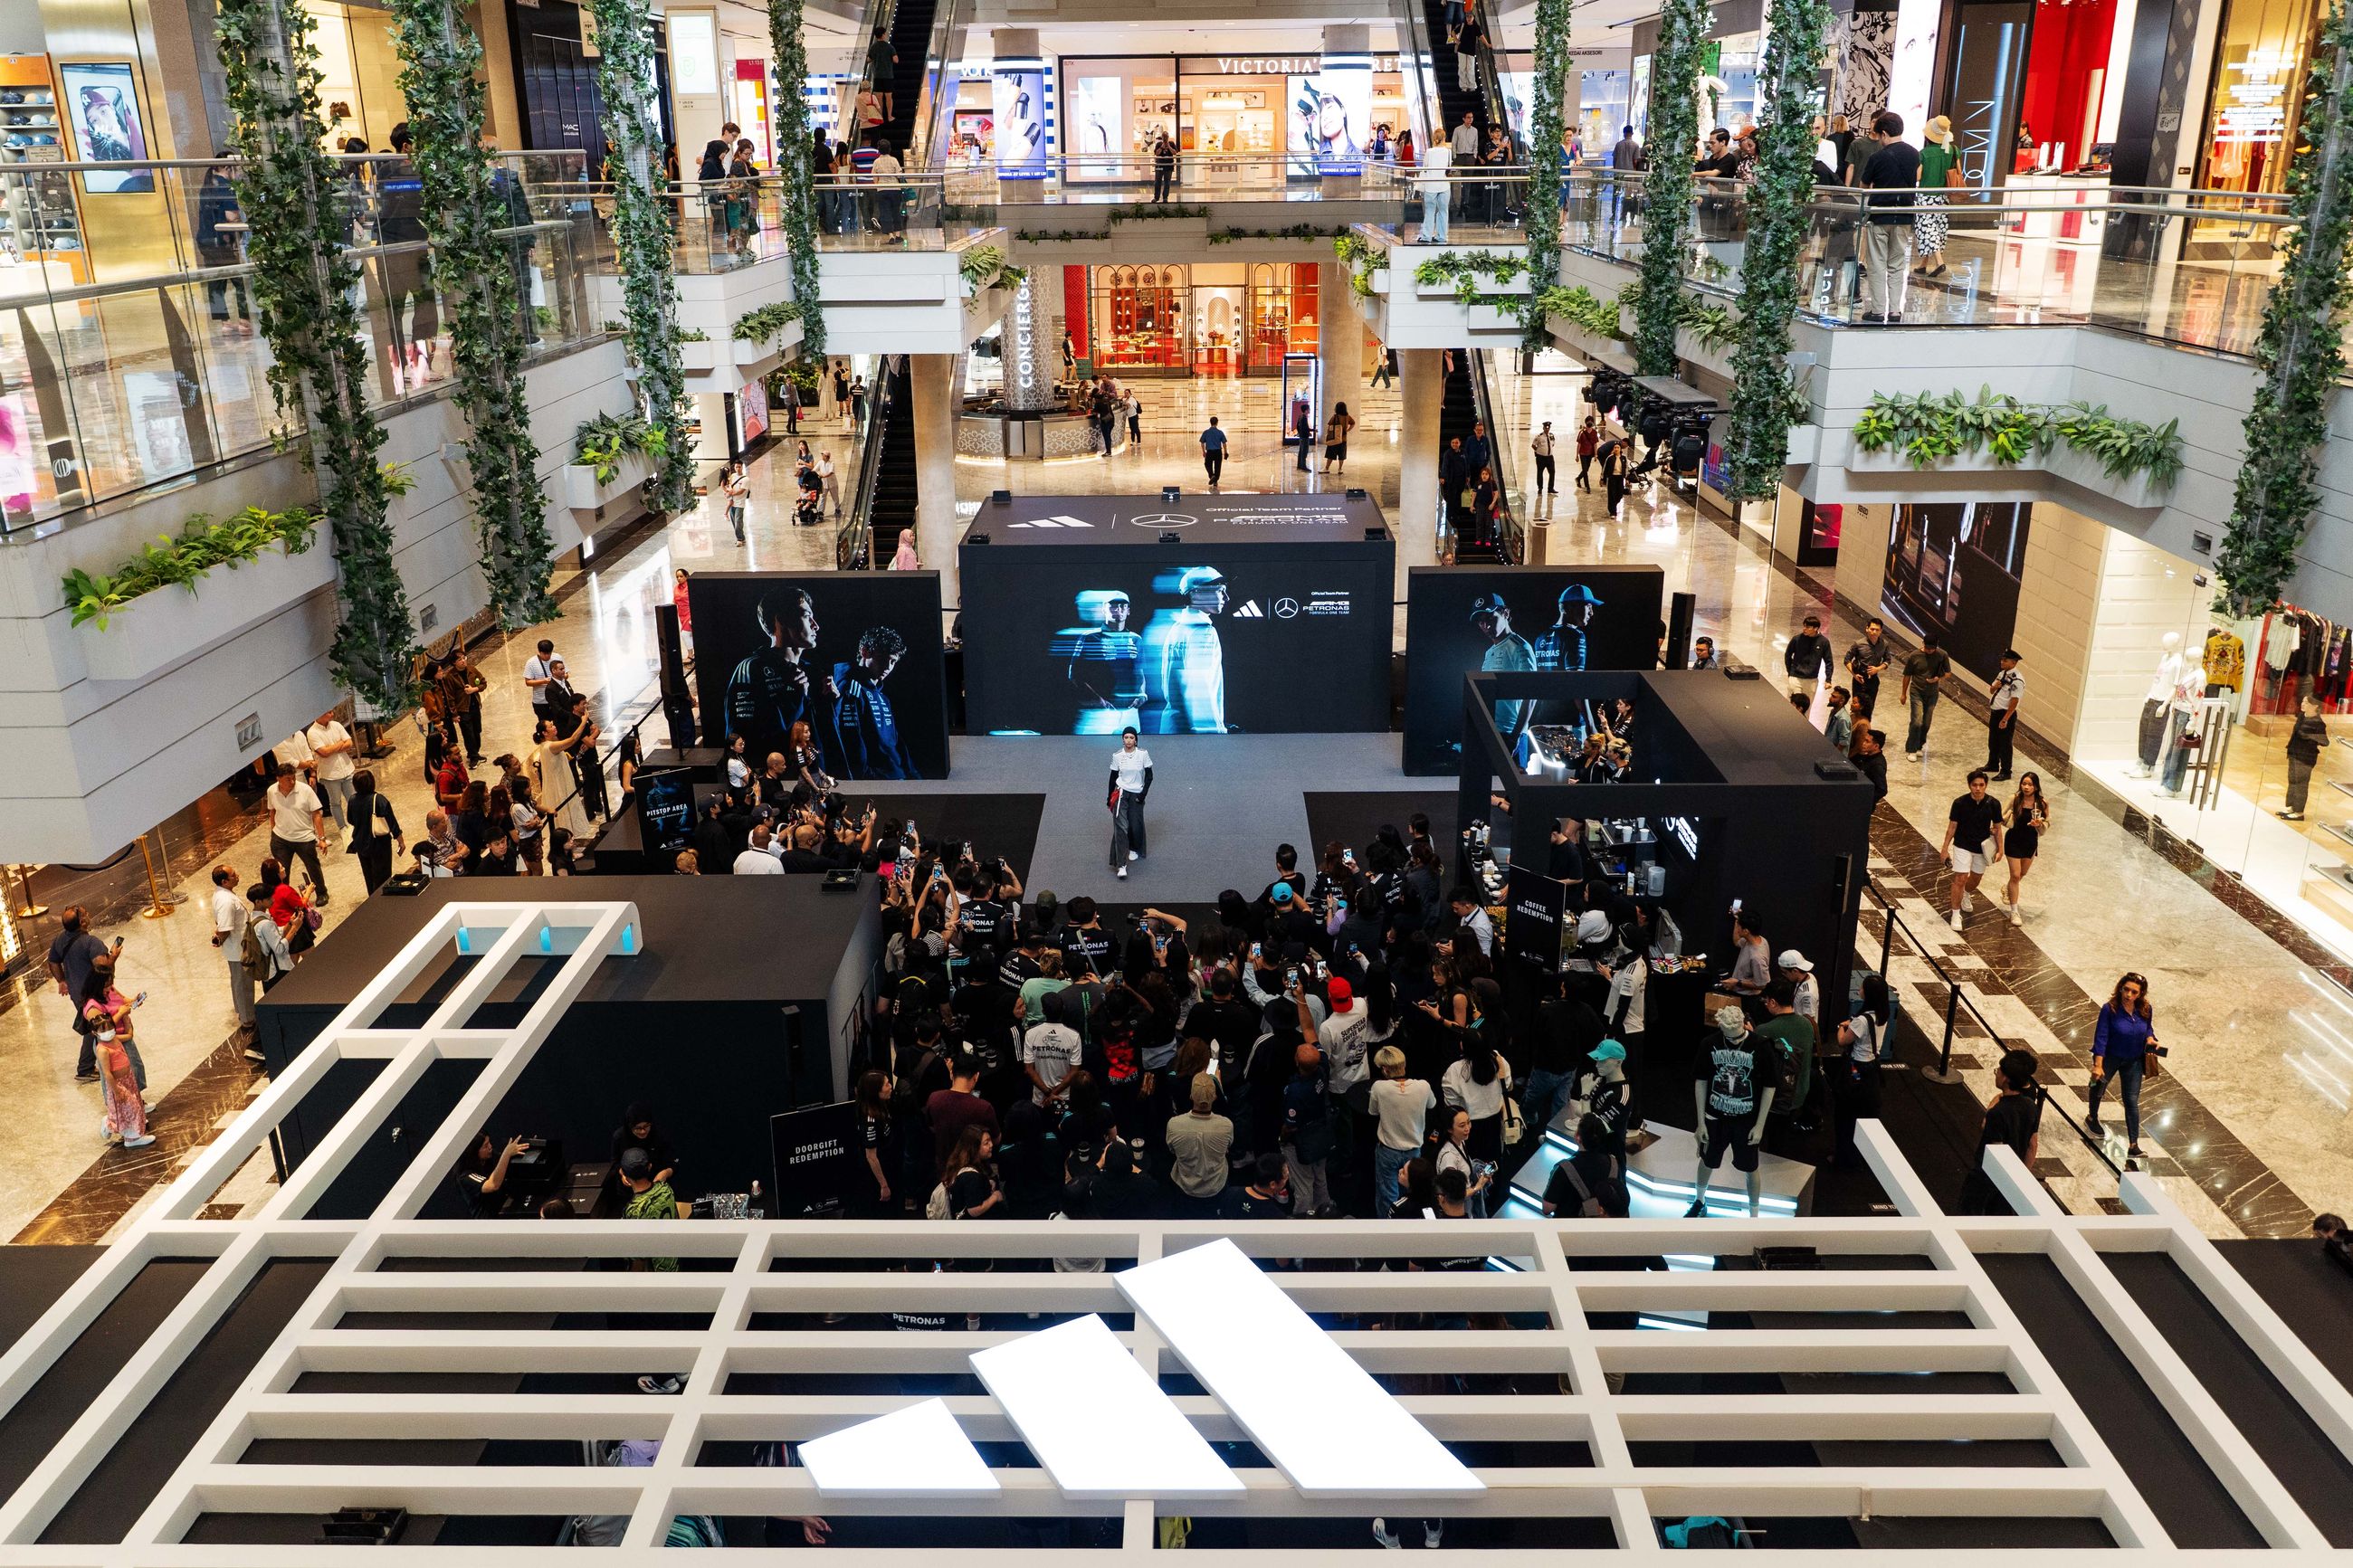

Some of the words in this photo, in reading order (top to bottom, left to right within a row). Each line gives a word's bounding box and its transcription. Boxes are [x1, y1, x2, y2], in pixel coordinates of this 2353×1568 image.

[1217, 58, 1321, 74] VICTORIA'
[1371, 58, 1403, 72] RET
[646, 807, 672, 817] PITSTOP
[672, 803, 688, 813] AREA
[1516, 904, 1554, 923] REDEMPTION
[1524, 900, 1546, 912] COFFEE
[1341, 1017, 1366, 1037] SUPERSTAR
[1032, 1045, 1072, 1054] PETRONAS
[789, 1146, 844, 1164] REDEMPTION
[795, 1139, 838, 1155] DOORGIFT
[892, 1313, 946, 1326] PETRONAS
